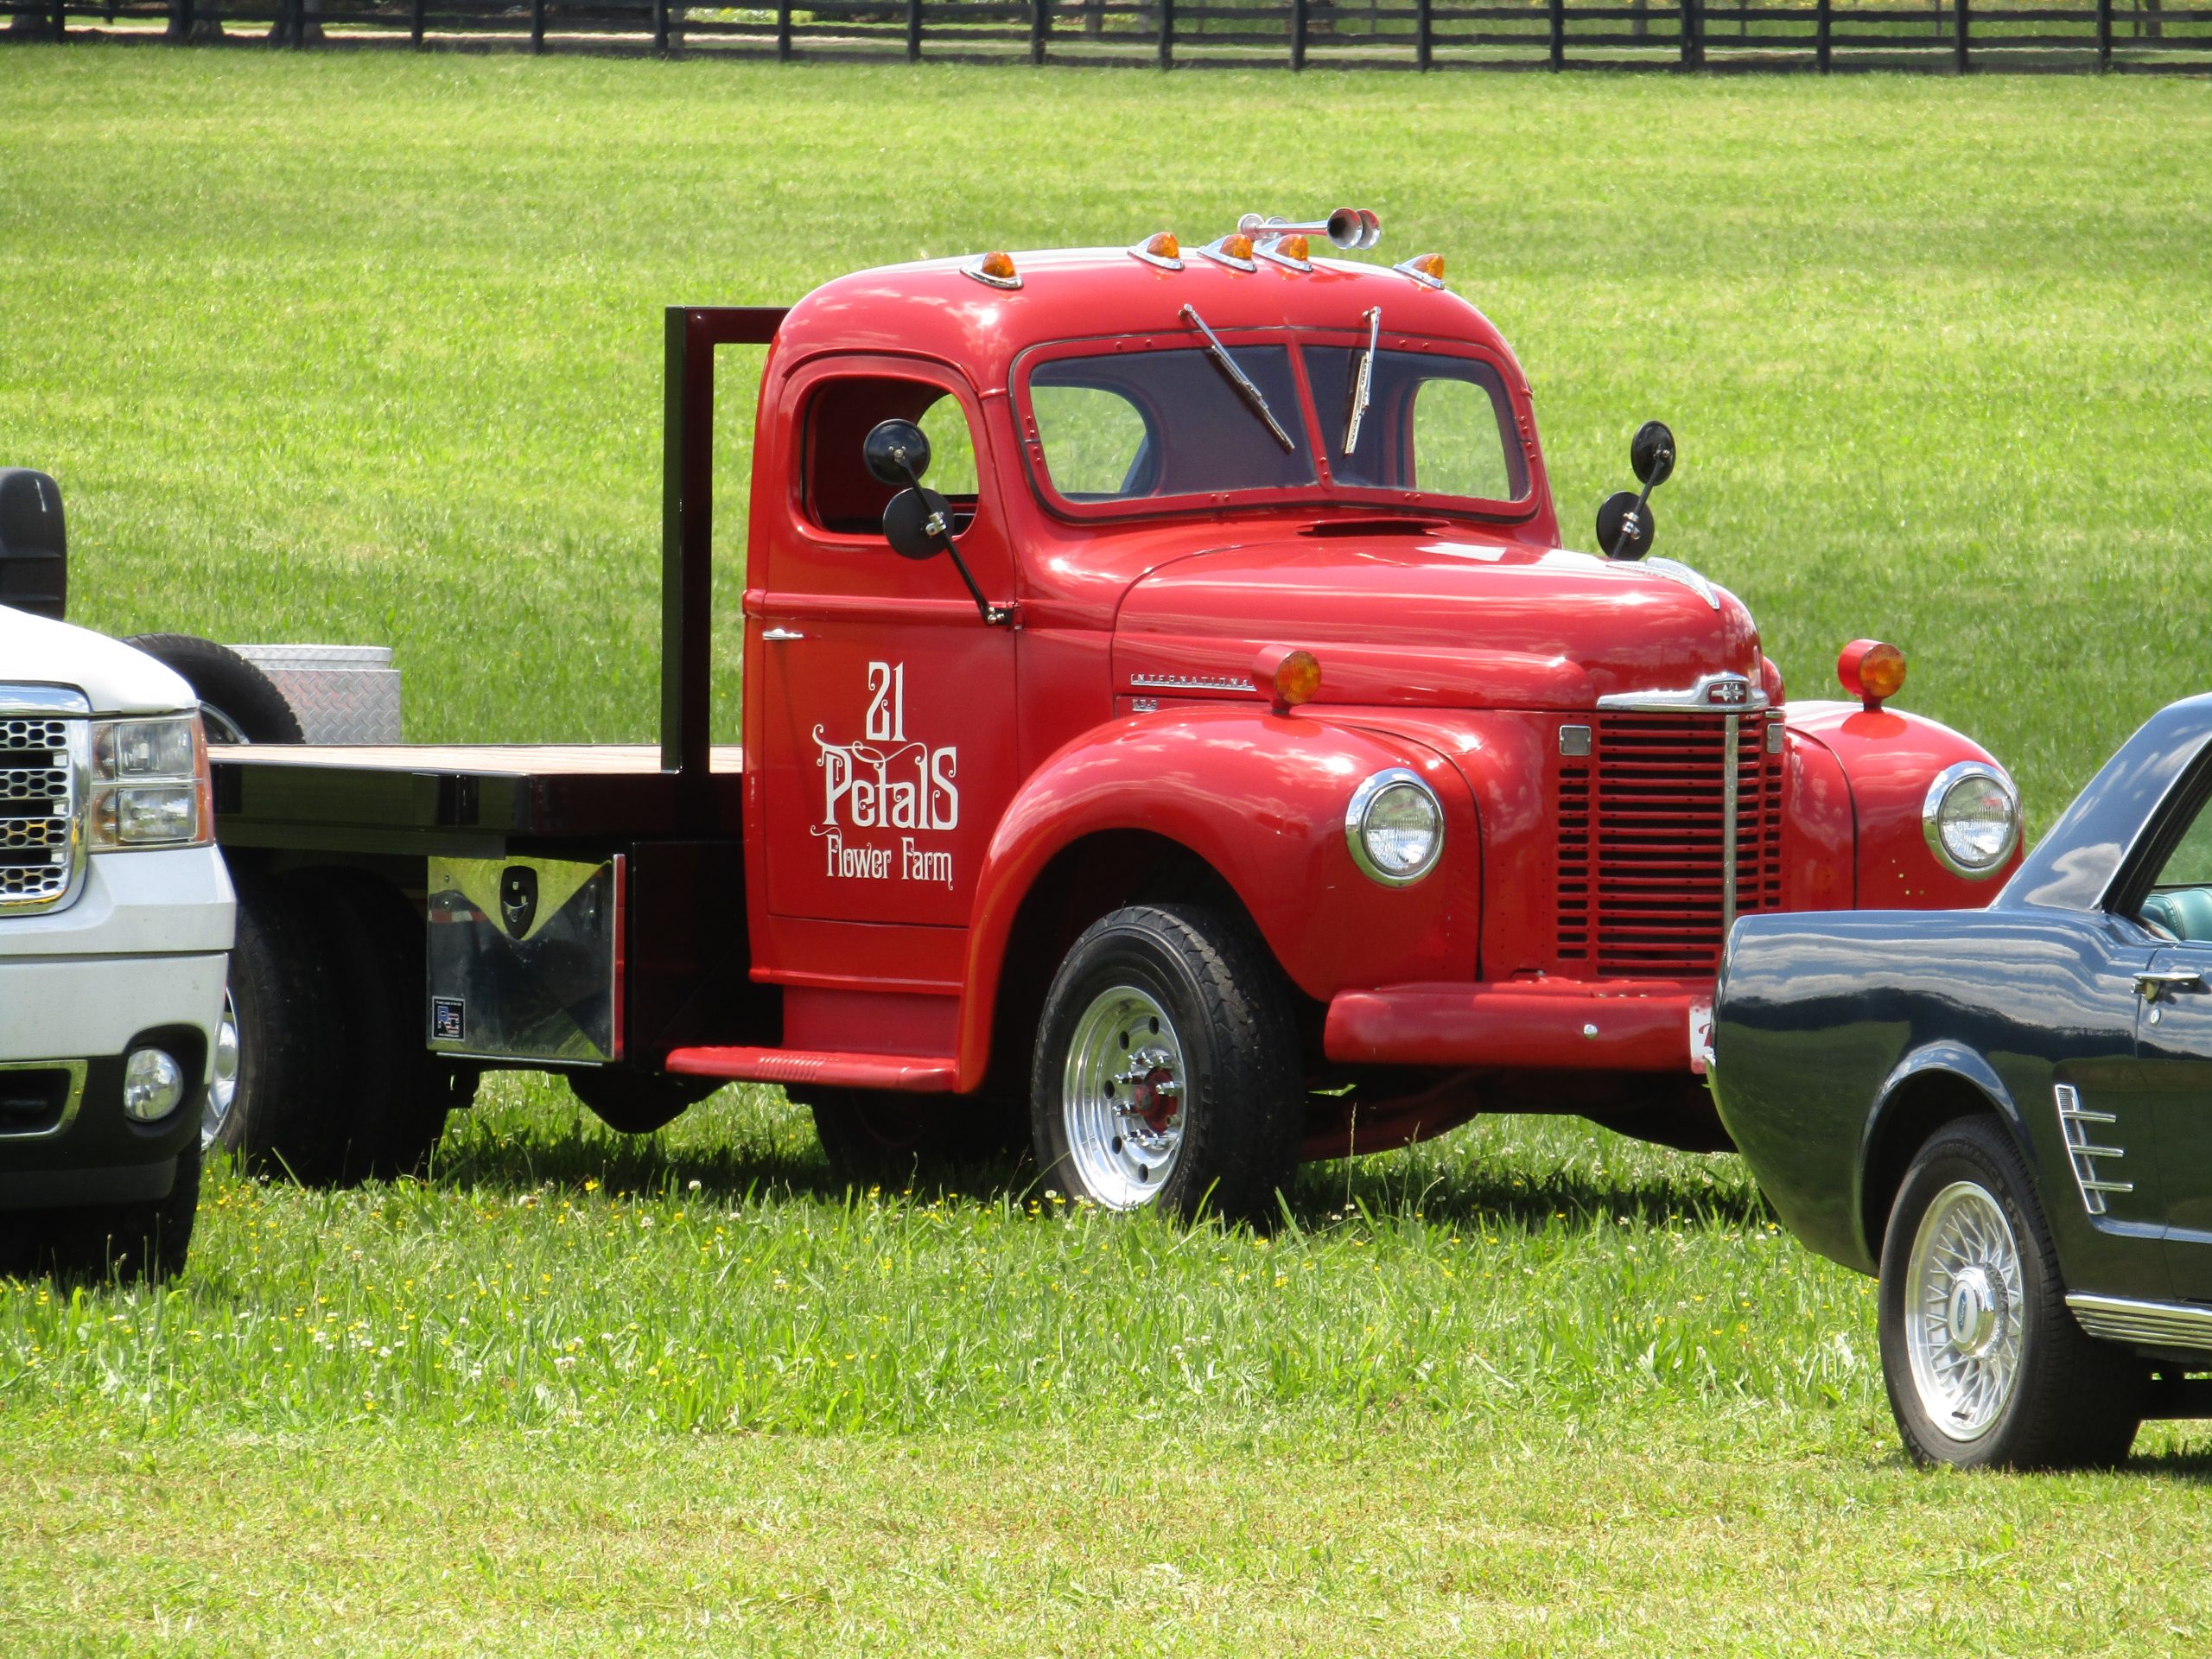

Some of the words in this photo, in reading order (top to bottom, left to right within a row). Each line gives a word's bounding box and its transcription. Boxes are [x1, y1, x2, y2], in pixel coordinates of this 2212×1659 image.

[866, 661, 907, 741] 21
[1130, 673, 1257, 690] INTERNATIONA
[810, 825, 892, 879] Flower
[900, 836, 954, 891] Farm
